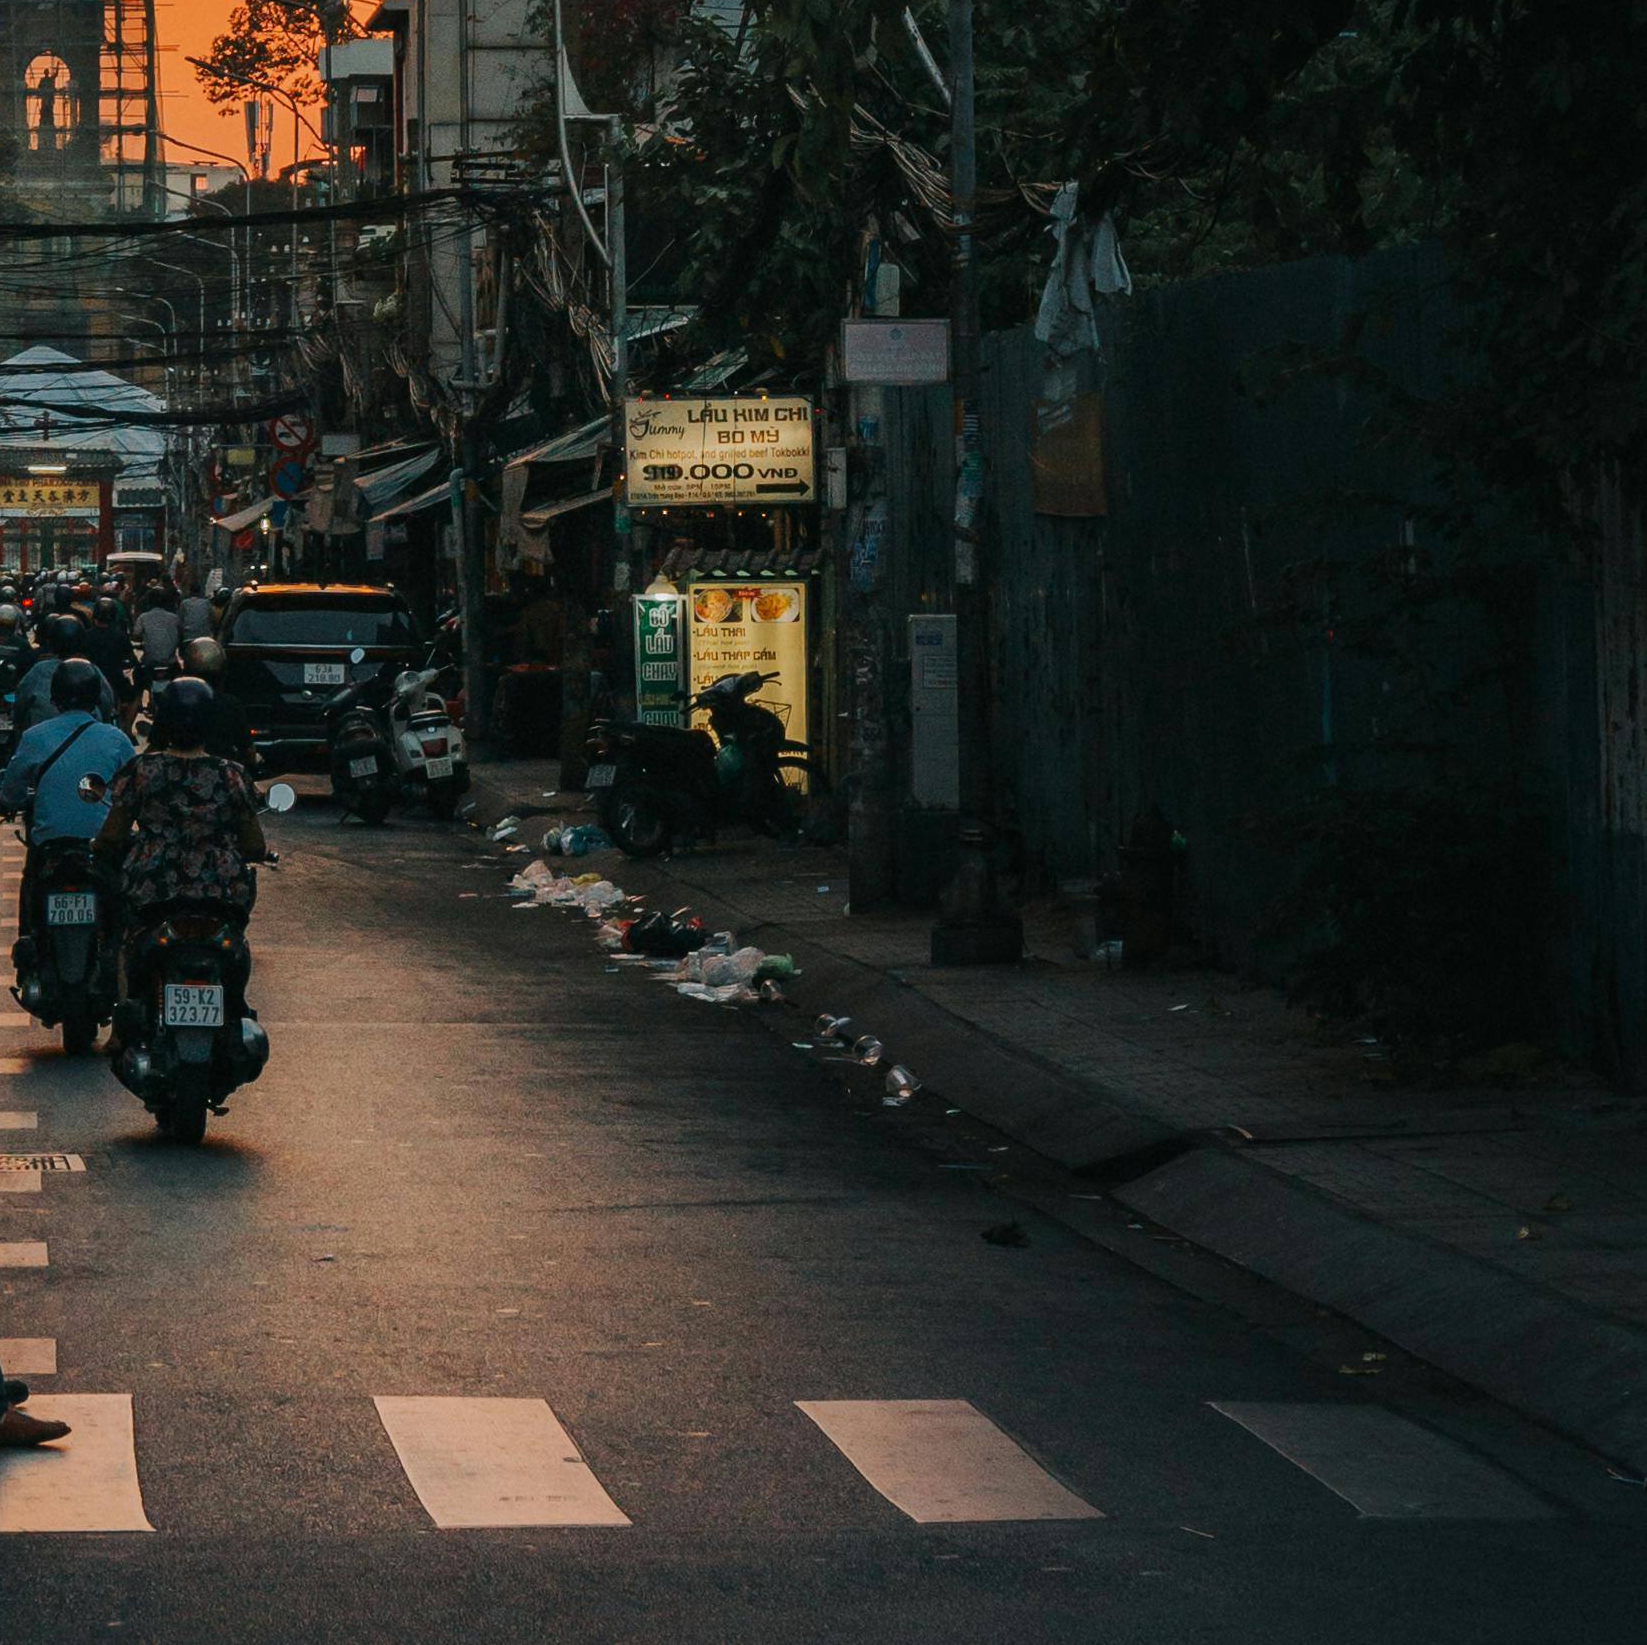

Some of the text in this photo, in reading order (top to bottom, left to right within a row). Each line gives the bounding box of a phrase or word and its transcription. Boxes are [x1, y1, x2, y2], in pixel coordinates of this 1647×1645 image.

[734, 407, 769, 422] KIM
[774, 407, 809, 421] CHI
[649, 449, 664, 459] Chi
[757, 467, 798, 479] VNĐ
[642, 662, 677, 681] CHAY
[54, 895, 87, 908] 66-F1
[50, 909, 92, 922] 700.06
[174, 988, 214, 1005] 59-K2
[169, 1006, 219, 1023] 323.77
